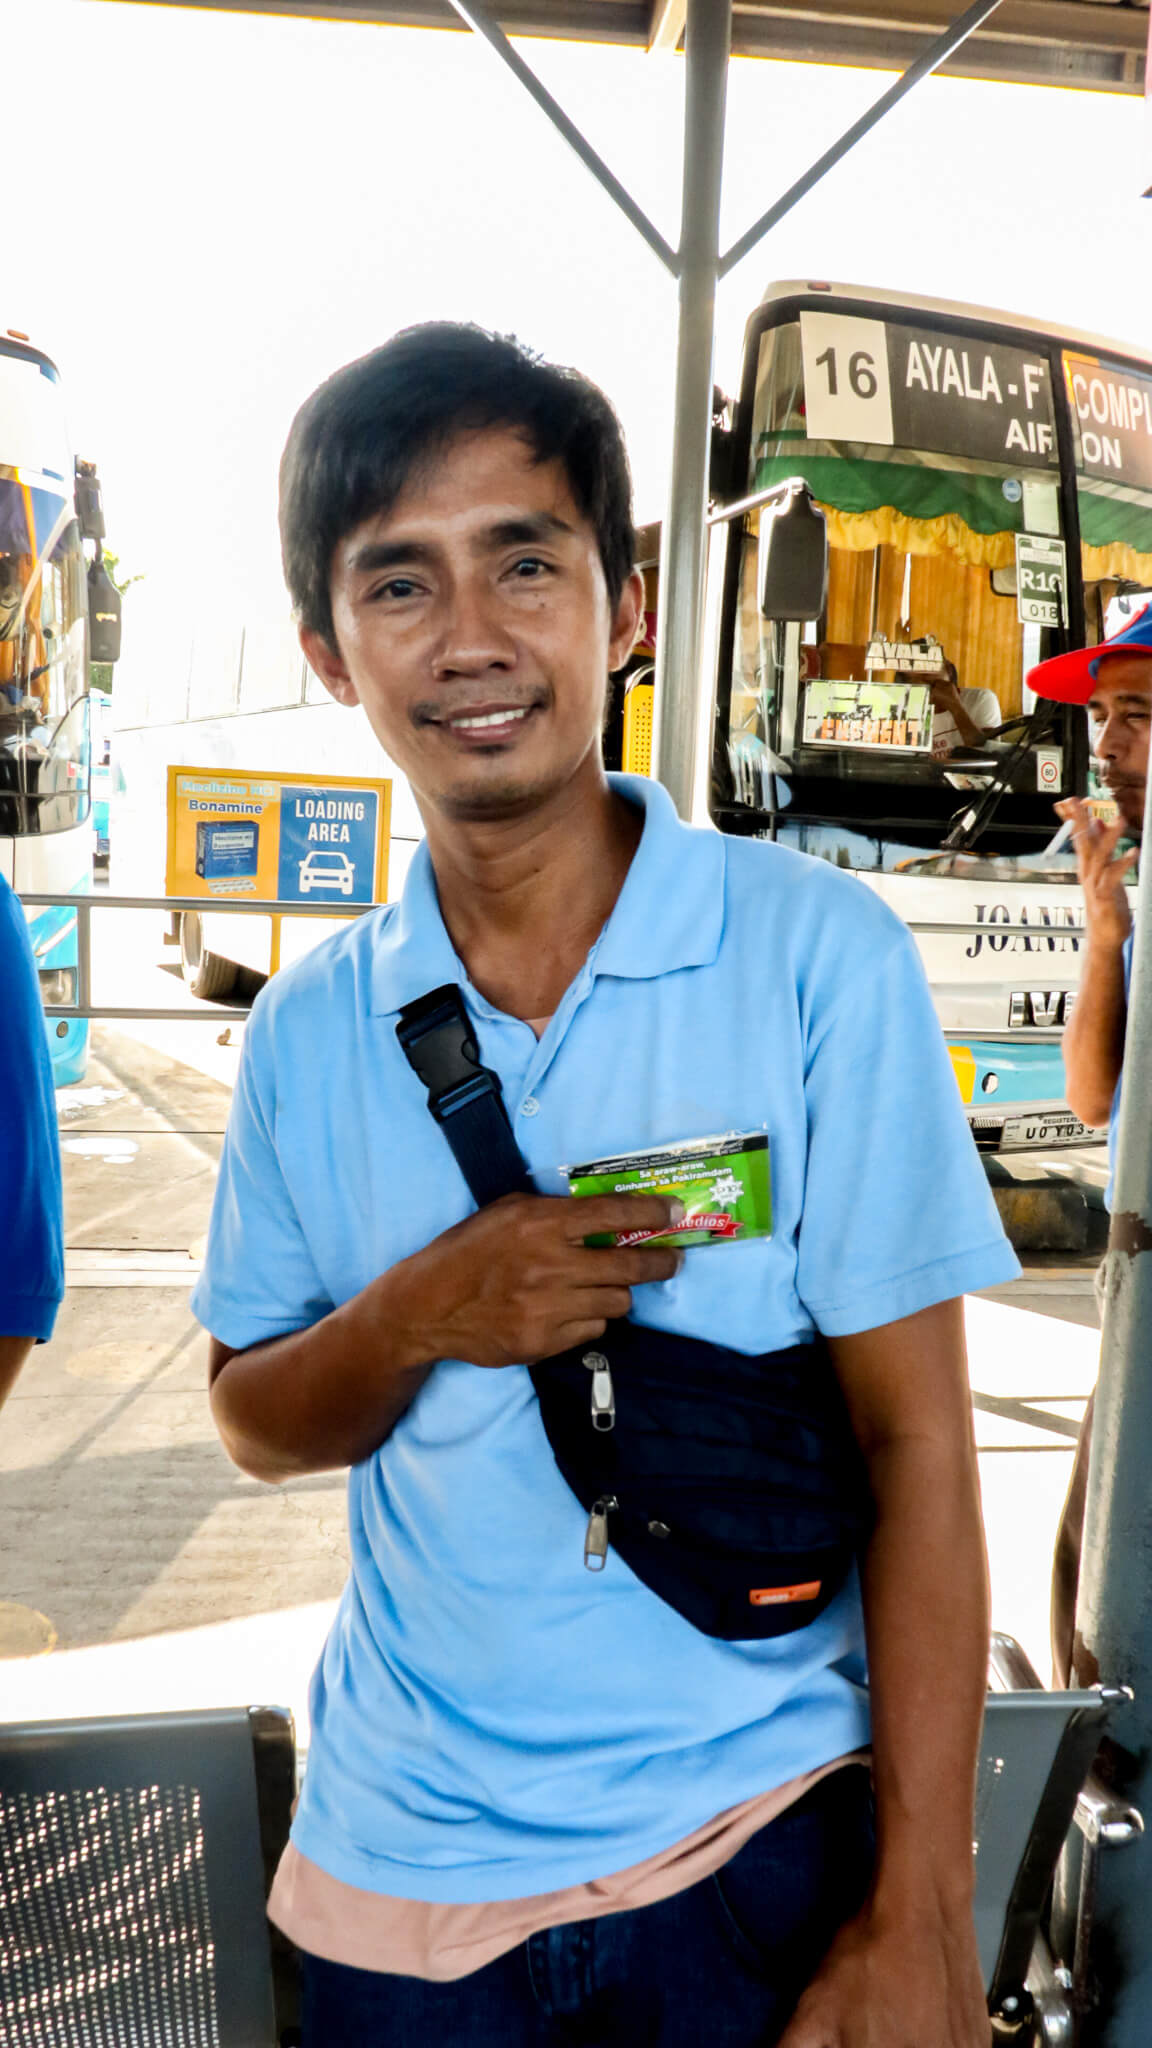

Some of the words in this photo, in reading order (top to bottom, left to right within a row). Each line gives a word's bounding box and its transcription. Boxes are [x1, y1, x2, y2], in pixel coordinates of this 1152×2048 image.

[816, 347, 878, 399] 16
[906, 341, 1003, 404] AYALA
[188, 799, 263, 814] Bonamine
[295, 799, 365, 821] LOADING
[307, 822, 350, 843] AREA
[614, 1180, 657, 1193] Ginhawa
[659, 1177, 671, 1186] sa
[672, 1167, 733, 1183] Pakiramdam
